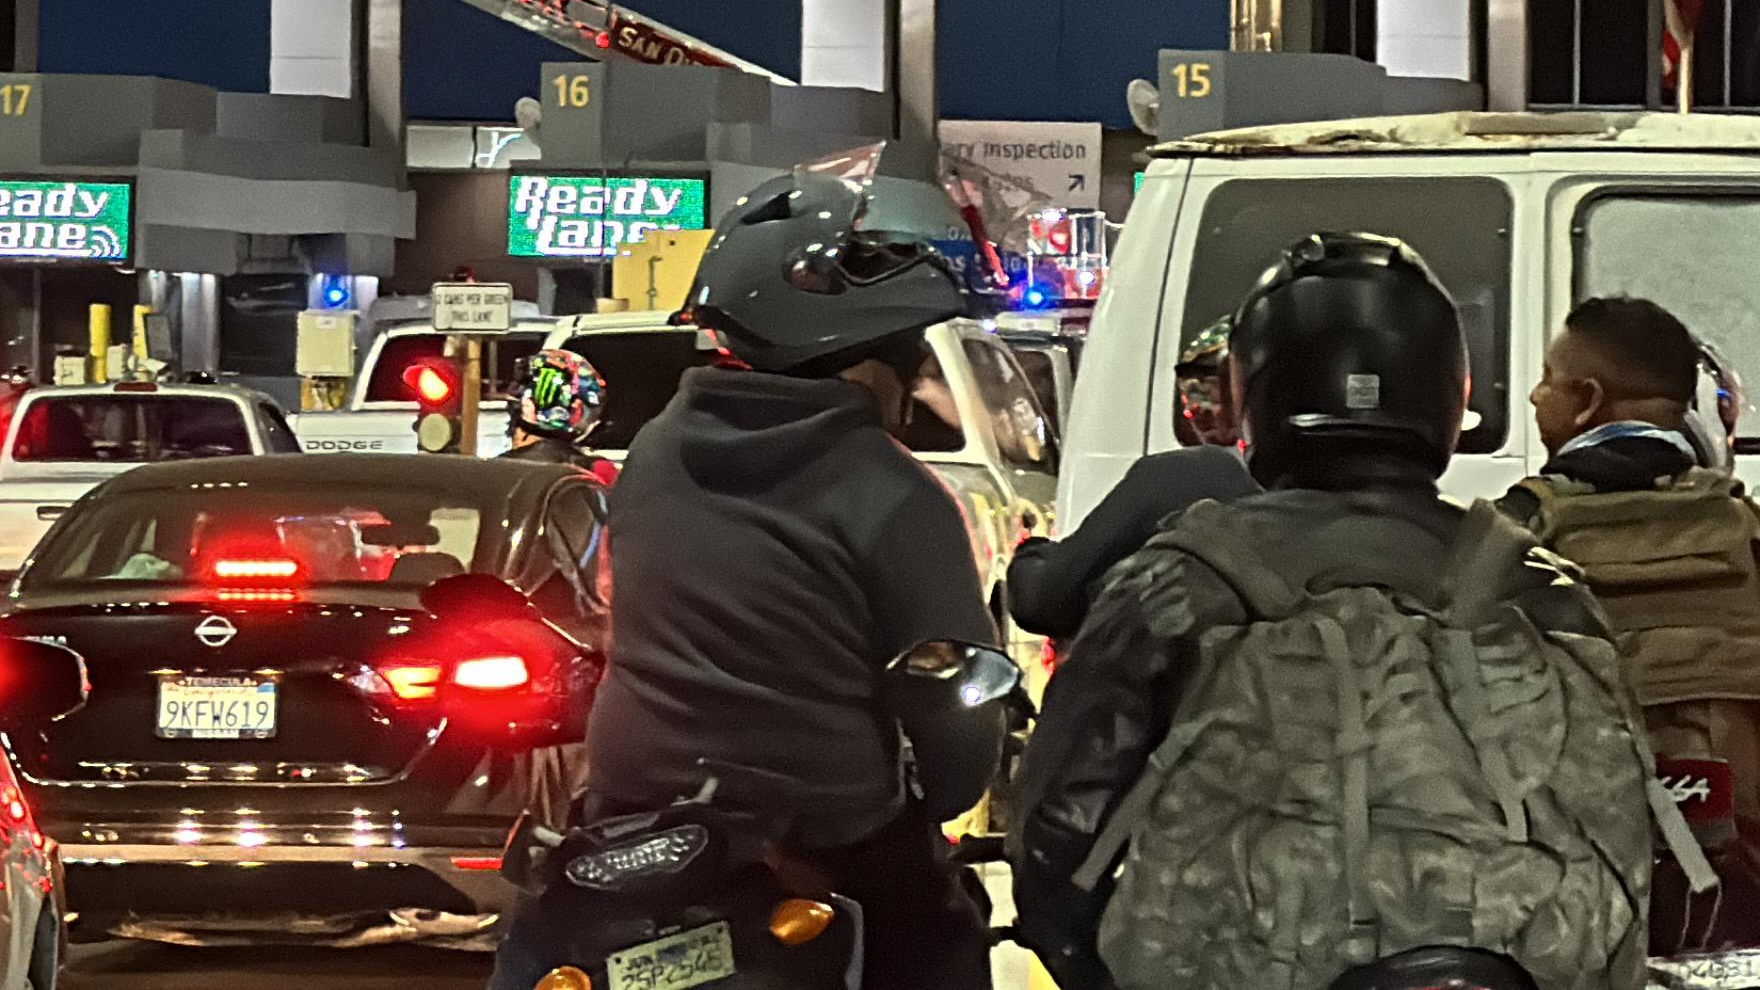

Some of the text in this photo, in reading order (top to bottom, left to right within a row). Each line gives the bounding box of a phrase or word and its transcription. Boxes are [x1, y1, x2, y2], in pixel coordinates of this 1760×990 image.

[554, 74, 589, 107] 16
[1172, 63, 1211, 98] 15
[0, 84, 31, 115] 17
[514, 177, 681, 230] Ready
[305, 440, 384, 451] DODGE
[166, 701, 270, 730] 9KFW619
